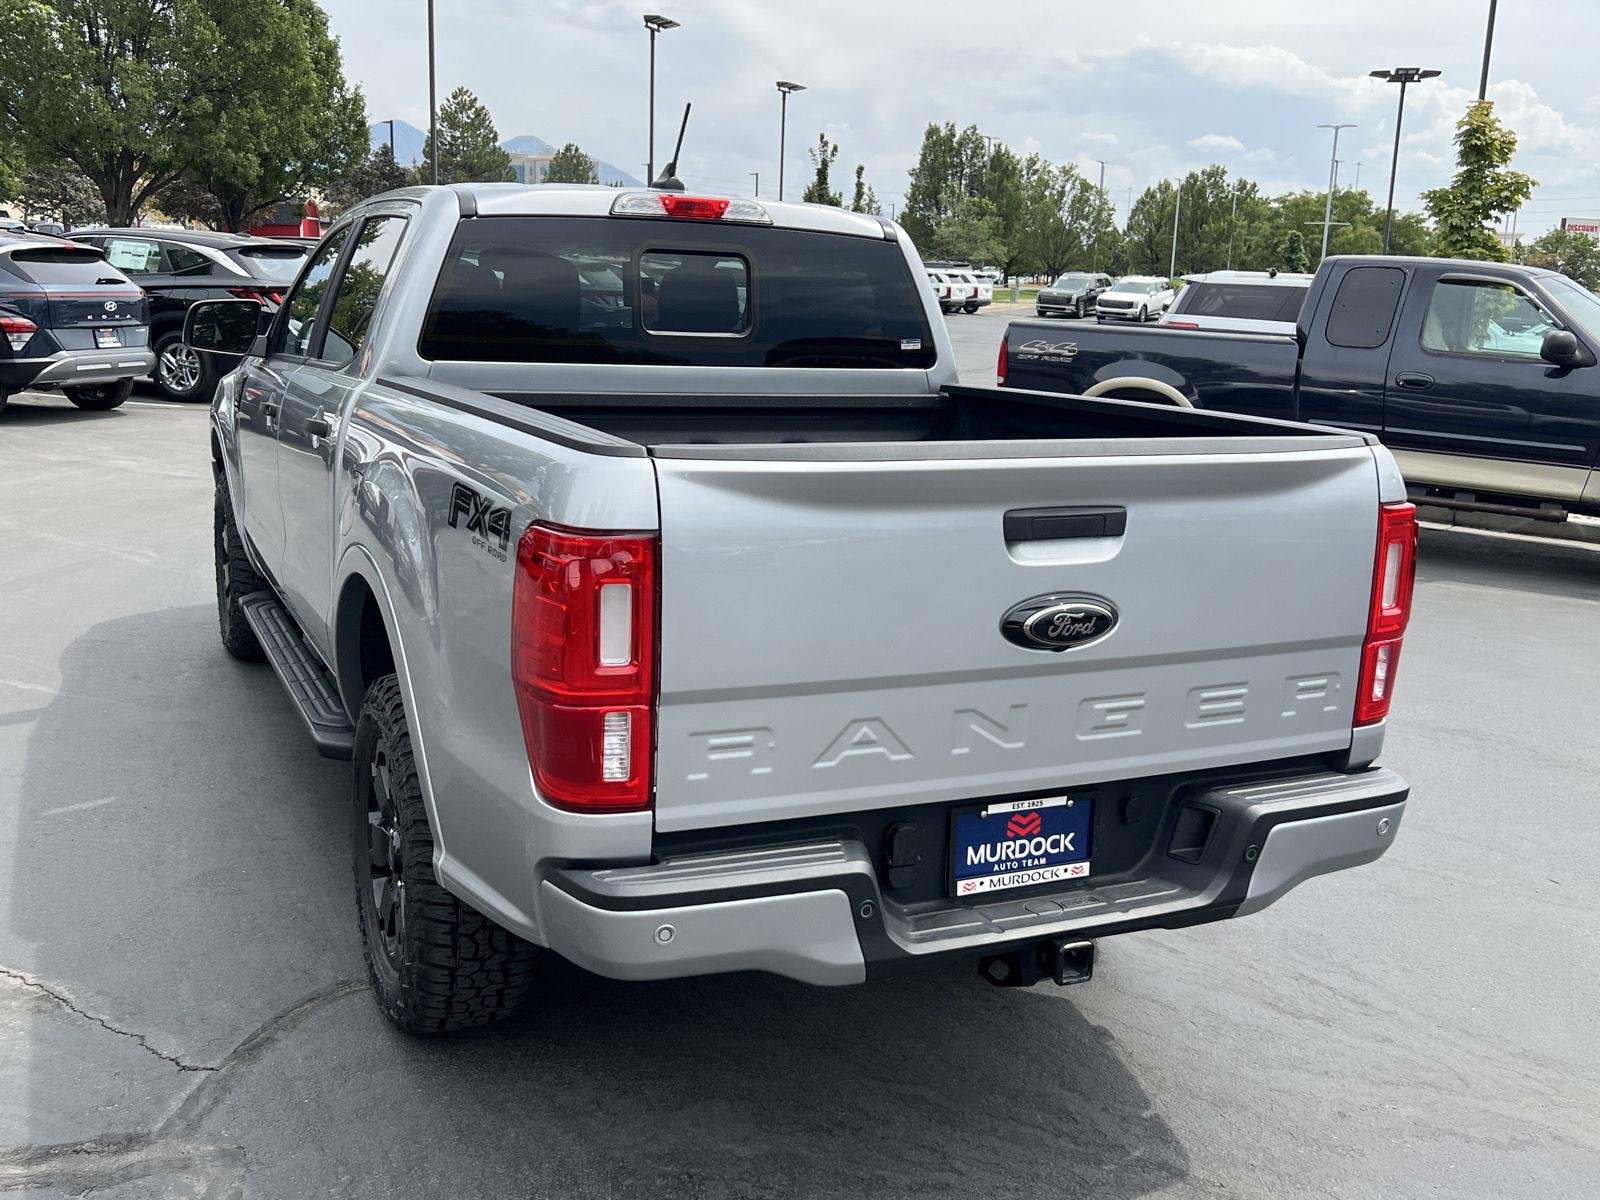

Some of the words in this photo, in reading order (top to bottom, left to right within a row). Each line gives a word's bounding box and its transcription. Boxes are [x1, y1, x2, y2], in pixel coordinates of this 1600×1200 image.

[447, 481, 512, 552] FX4
[472, 536, 487, 550] OFF
[487, 546, 507, 562] ROAD
[1047, 612, 1097, 638] Ford
[687, 670, 1342, 781] RANGER
[1027, 800, 1044, 808] 1925
[966, 832, 1075, 865] MURDOCK
[993, 861, 1018, 872] AUTO
[1023, 857, 1047, 866] TEAM
[989, 869, 1060, 888] MURDOCK
